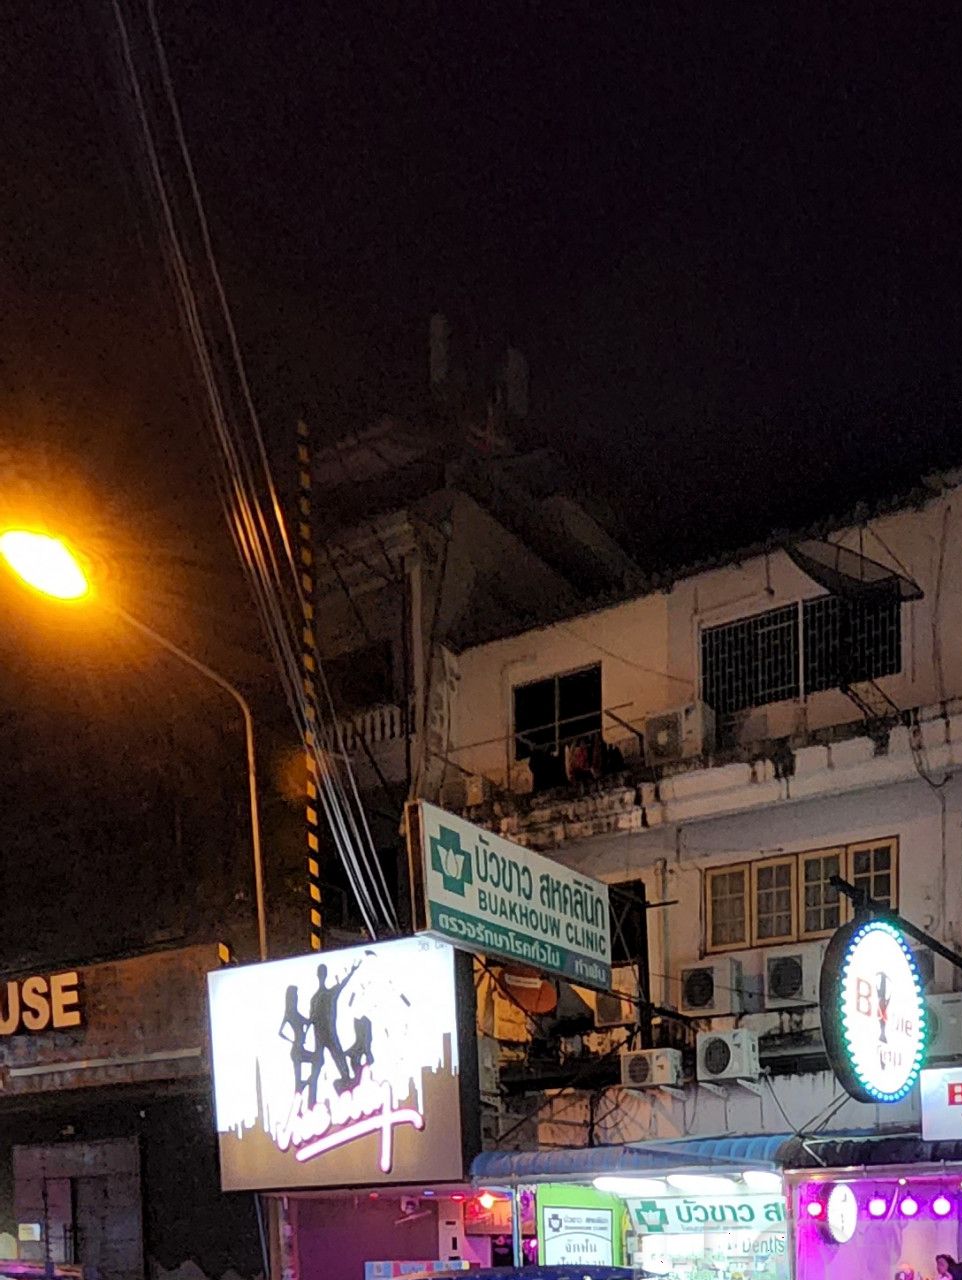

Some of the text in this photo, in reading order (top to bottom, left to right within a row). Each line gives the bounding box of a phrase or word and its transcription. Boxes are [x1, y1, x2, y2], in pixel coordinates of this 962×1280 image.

[475, 834, 605, 930] บัวขาว สหคลินิก
[478, 888, 606, 956] BUAKHOUW CLINIC
[0, 972, 81, 1035] USE
[675, 1199, 755, 1224] บัวขาว
